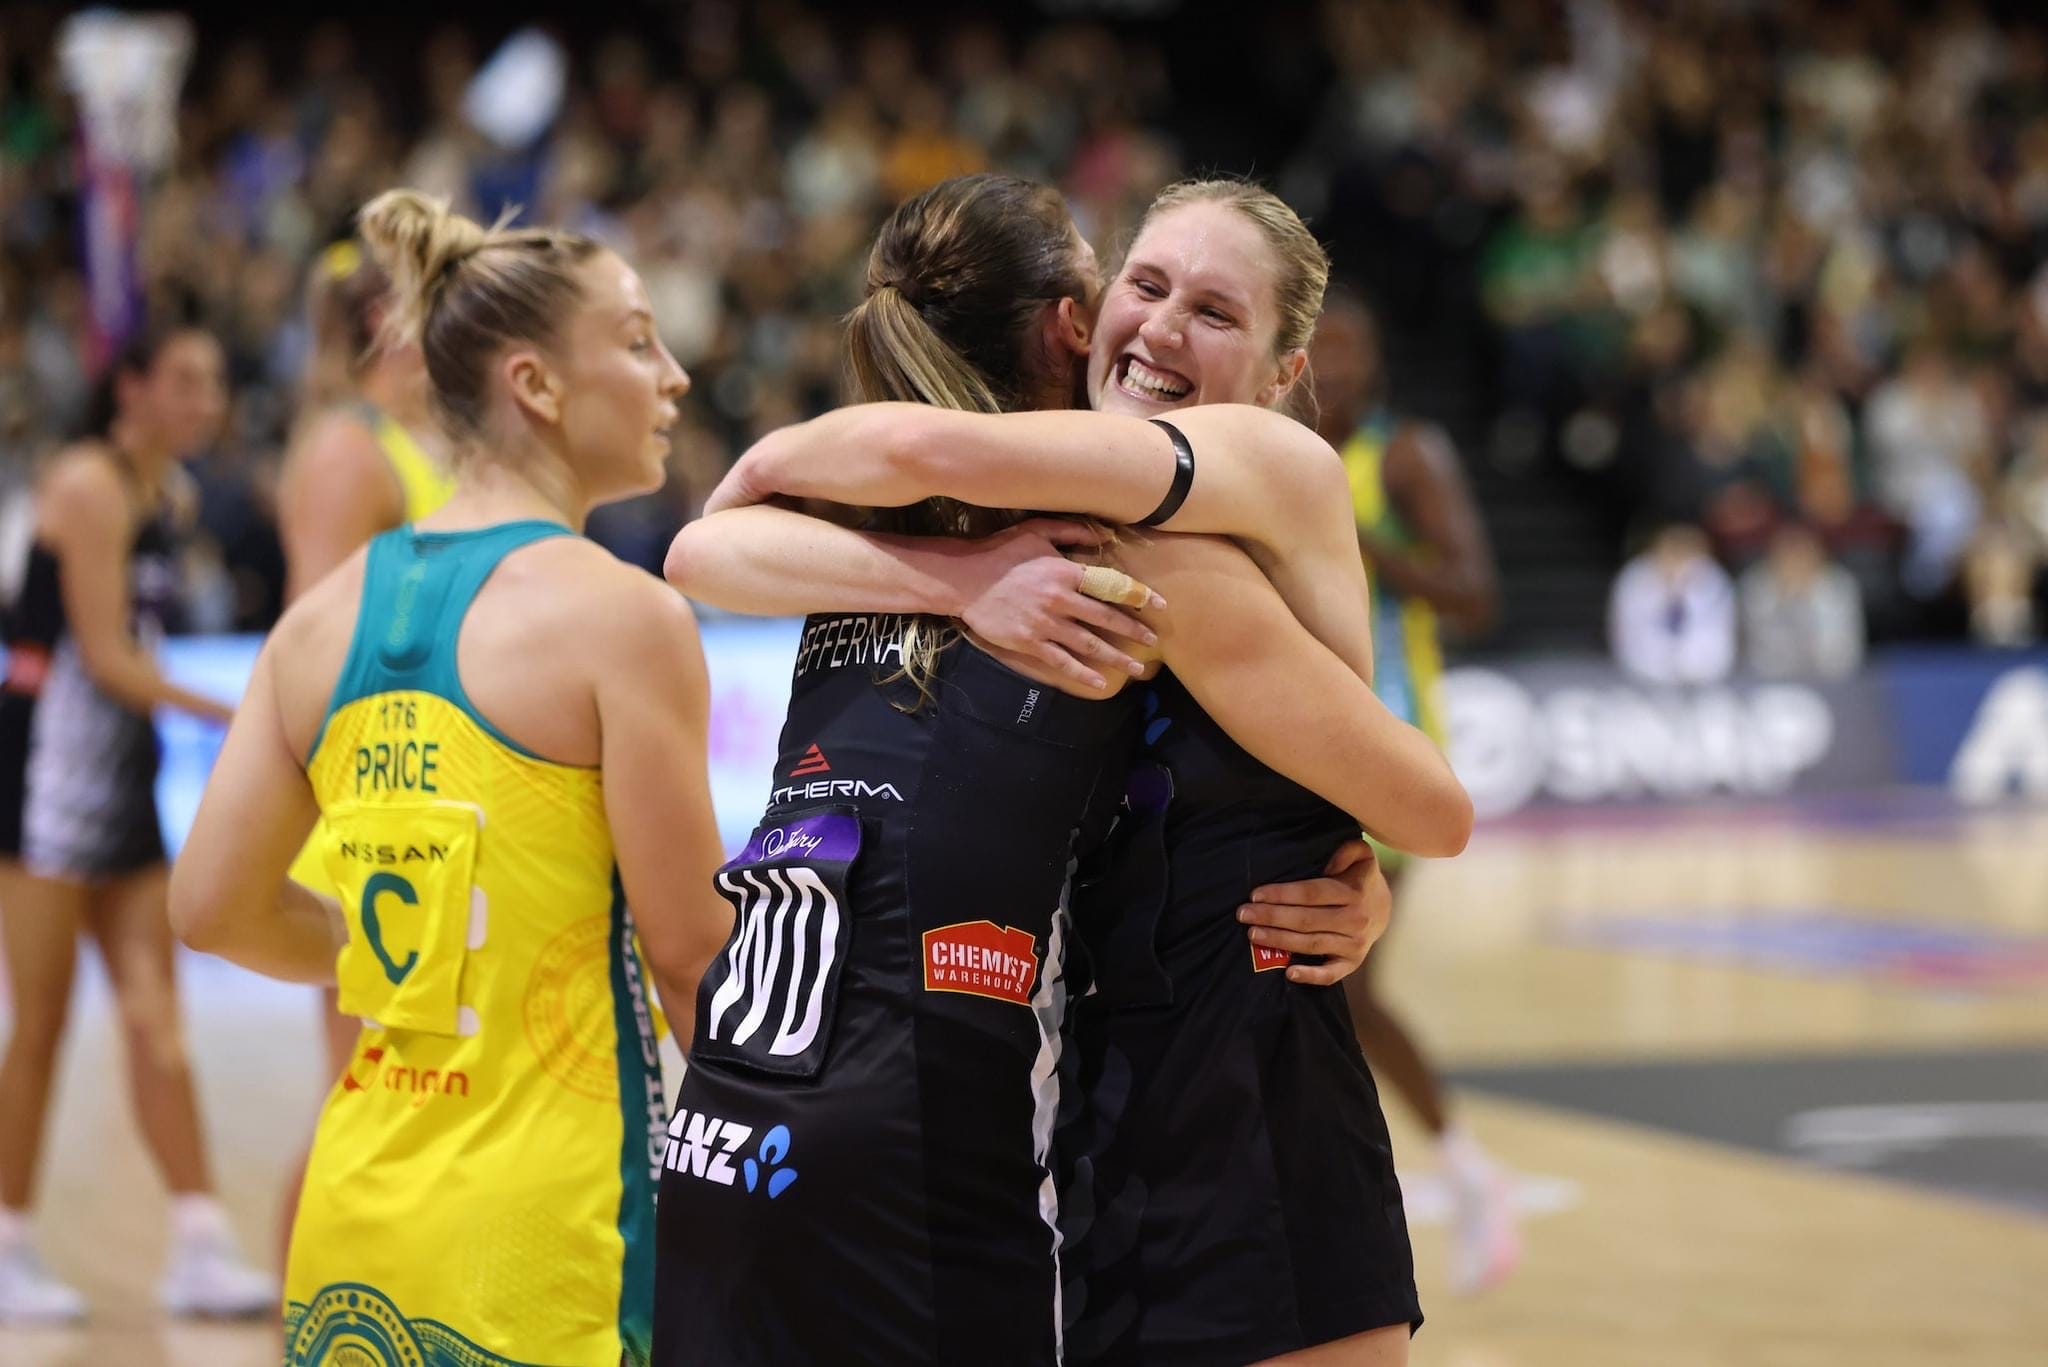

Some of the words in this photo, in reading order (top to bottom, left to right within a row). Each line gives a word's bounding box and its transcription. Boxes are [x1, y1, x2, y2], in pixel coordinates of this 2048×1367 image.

[380, 702, 416, 731] 176
[1017, 689, 1040, 724] DRYCELL
[356, 741, 439, 796] PRICE
[766, 780, 904, 812] THERM
[340, 843, 449, 864] NSSAN
[361, 872, 419, 985] C
[709, 867, 839, 1056] WD
[933, 968, 1022, 993] WAREHOUS
[666, 1108, 753, 1186] ANZ
